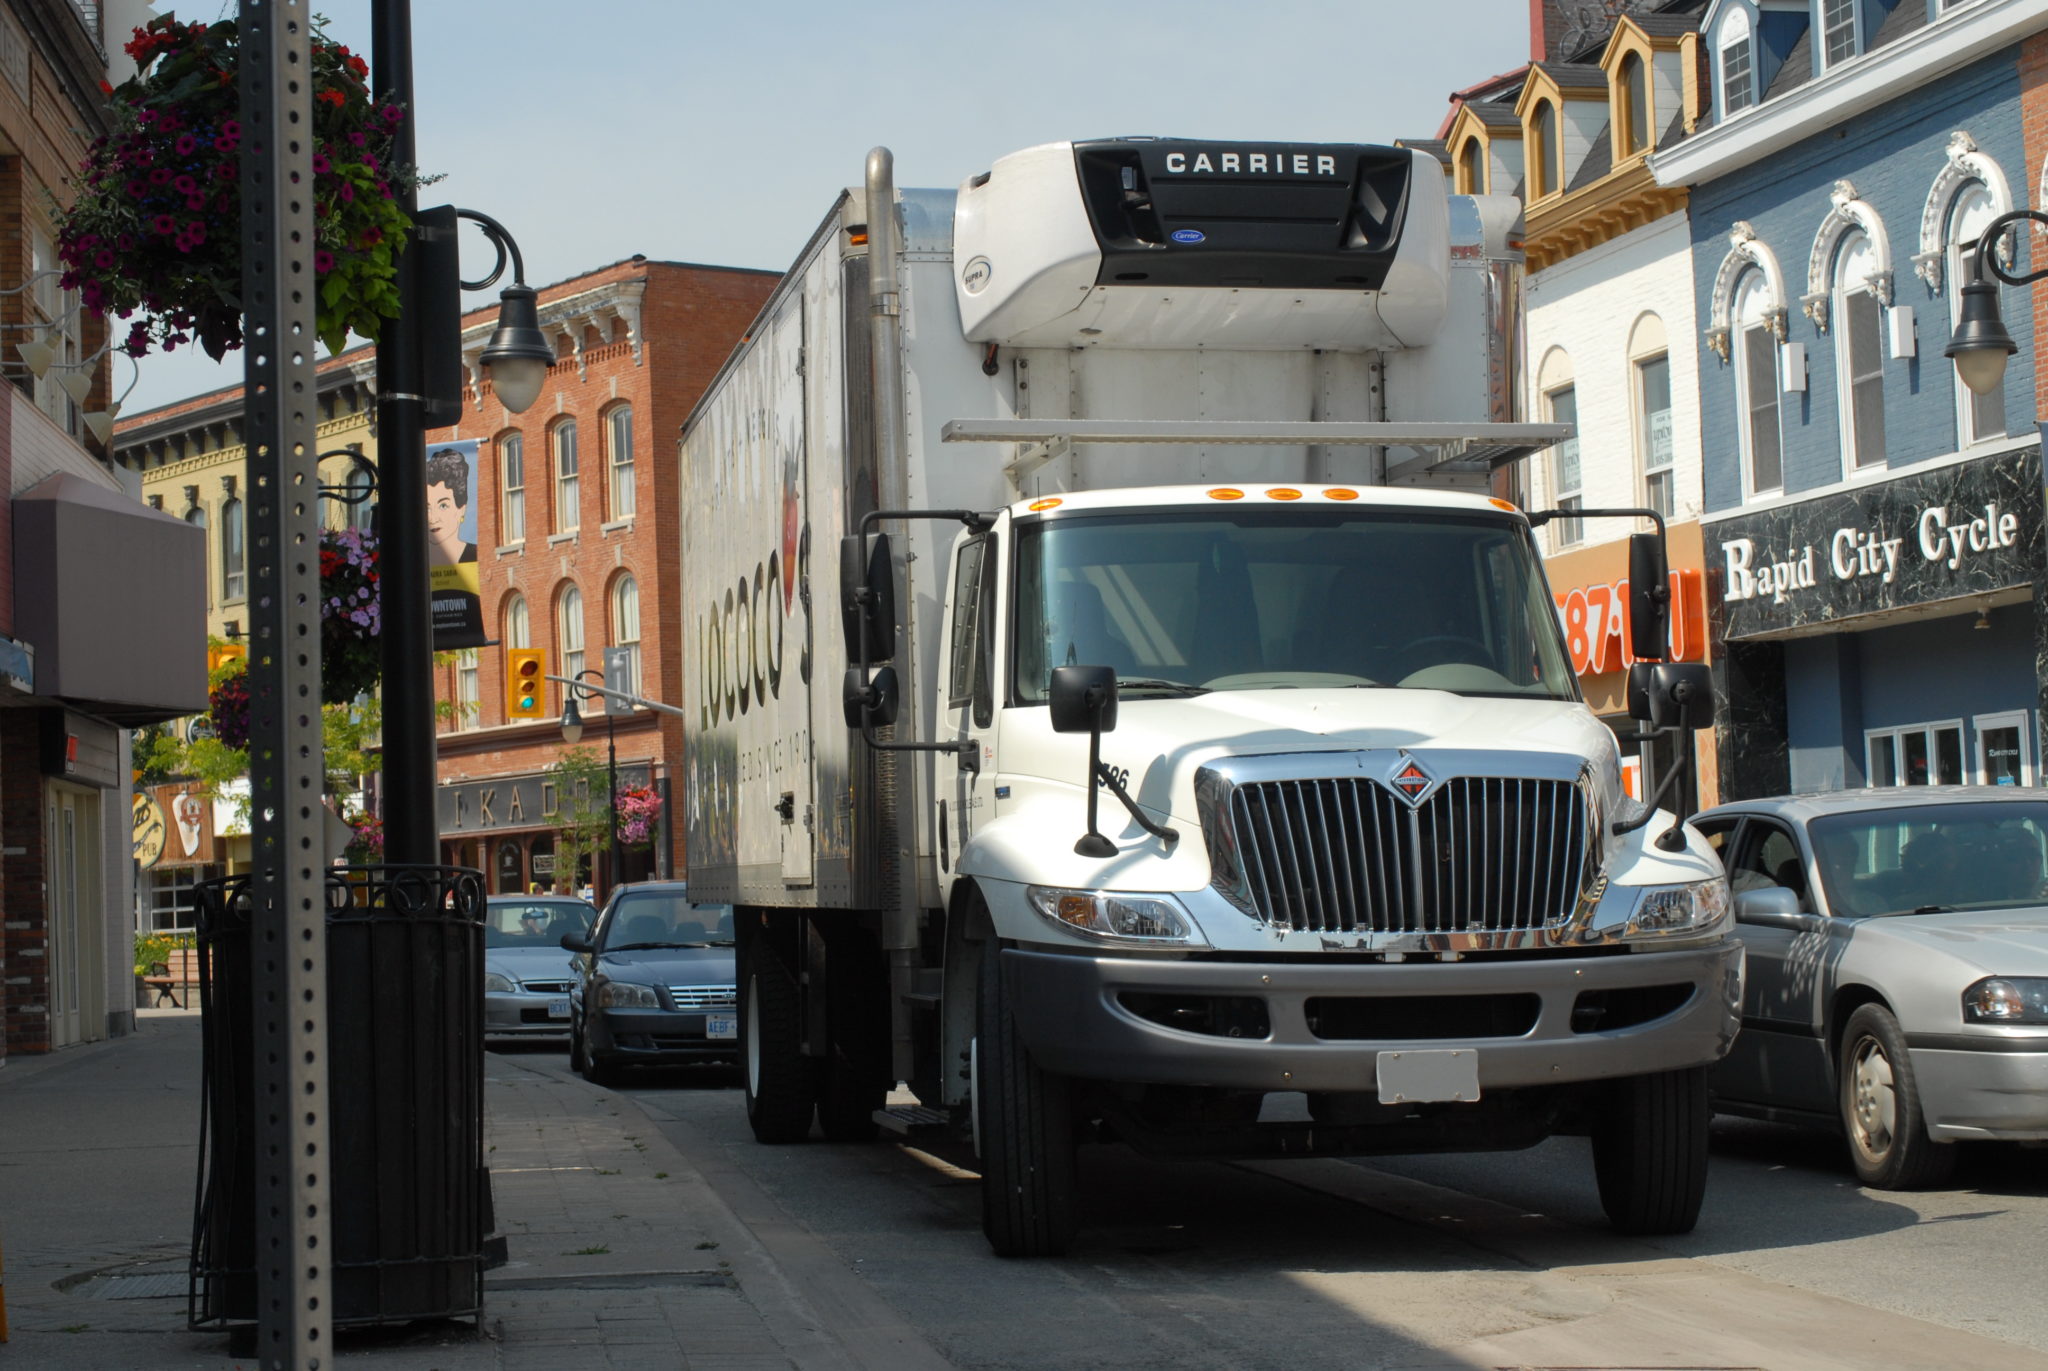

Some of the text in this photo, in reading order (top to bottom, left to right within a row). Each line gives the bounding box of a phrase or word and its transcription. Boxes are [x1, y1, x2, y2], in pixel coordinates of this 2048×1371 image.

[1166, 153, 1336, 176] CARRIER
[1175, 232, 1200, 240] Carrier
[965, 270, 983, 285] SUPRA
[1721, 503, 2018, 604] Rapid City Cycle
[142, 843, 157, 857] PUB
